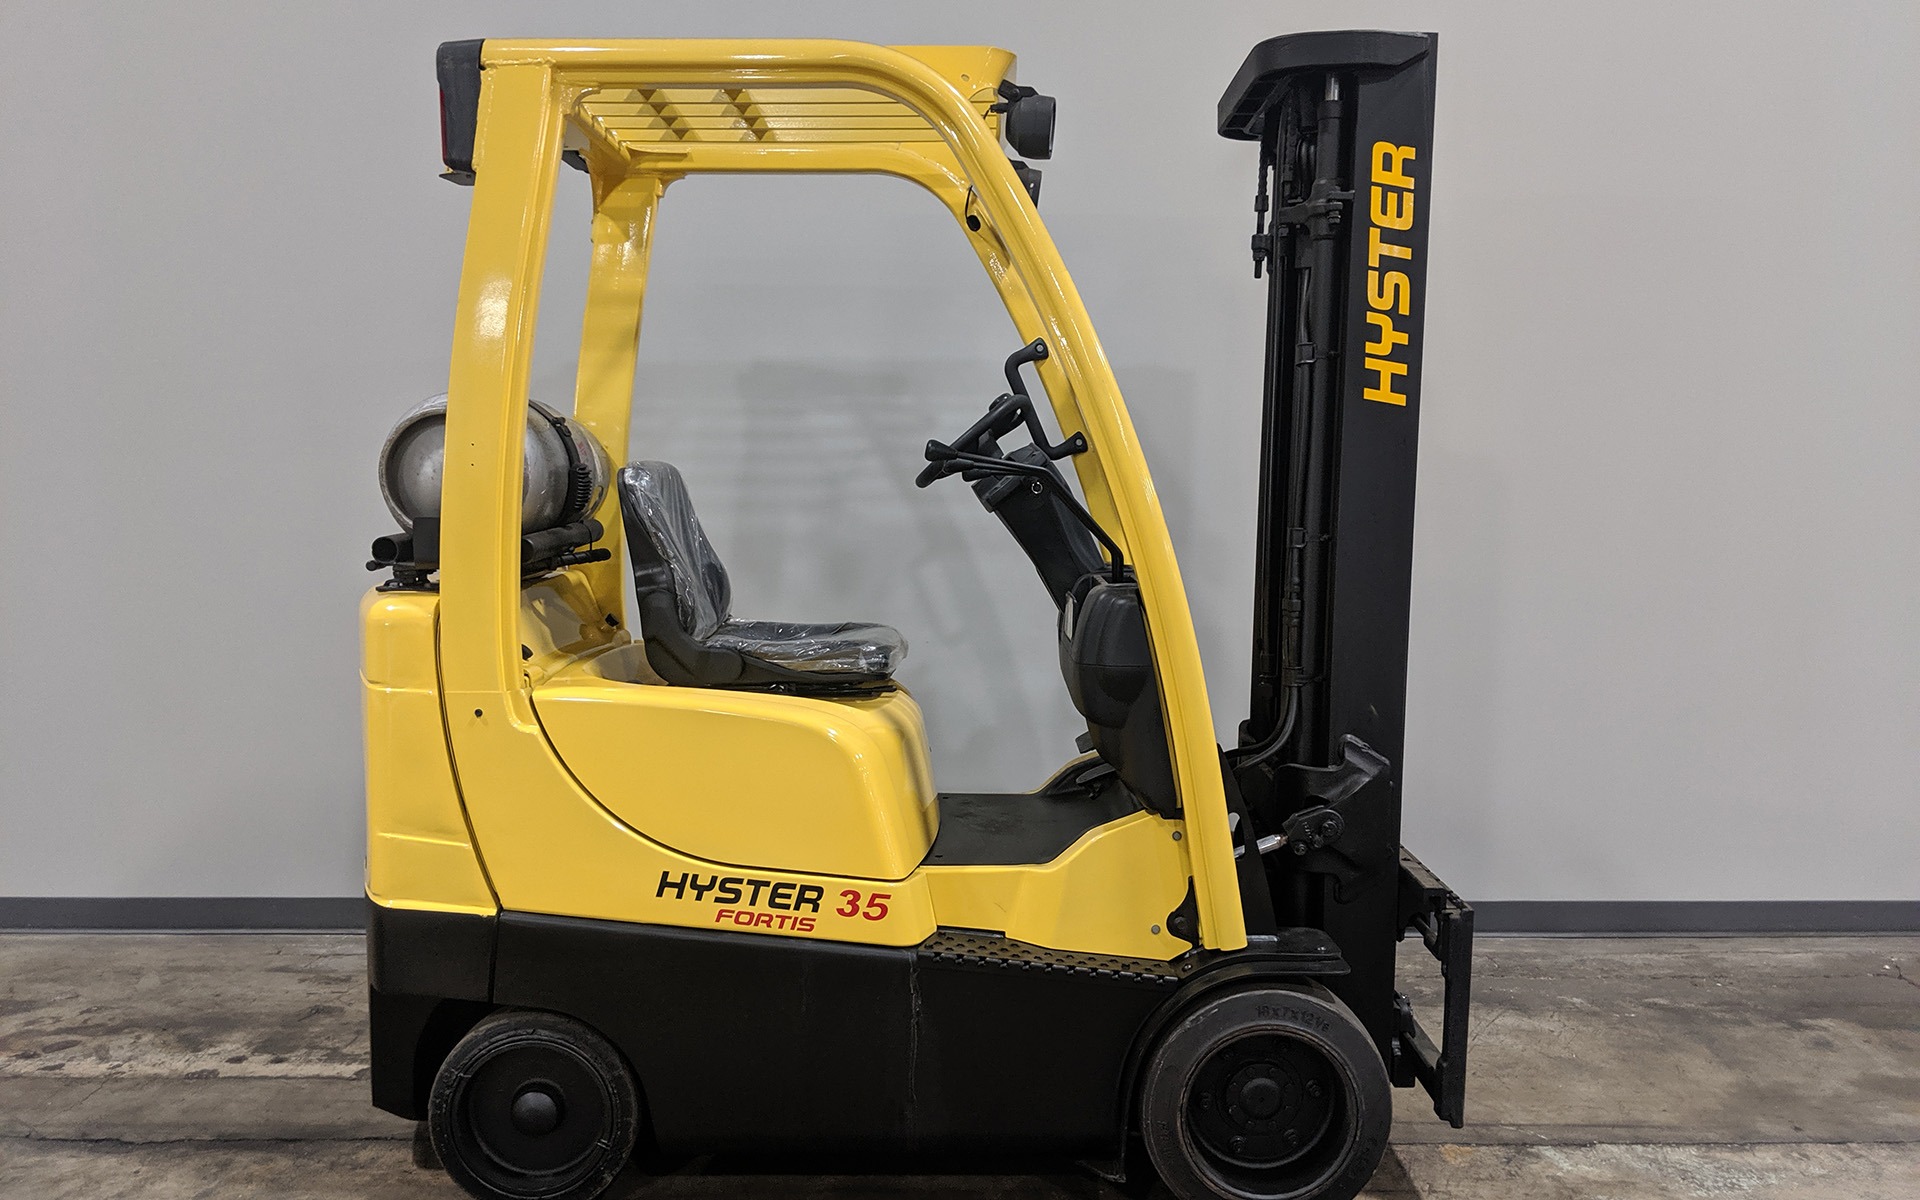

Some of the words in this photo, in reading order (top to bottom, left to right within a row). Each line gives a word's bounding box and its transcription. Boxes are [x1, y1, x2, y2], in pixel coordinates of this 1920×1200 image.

[1364, 141, 1416, 407] HYSTER
[656, 871, 824, 913] HYSTER
[836, 889, 892, 922] 35
[715, 908, 816, 932] FORTIS
